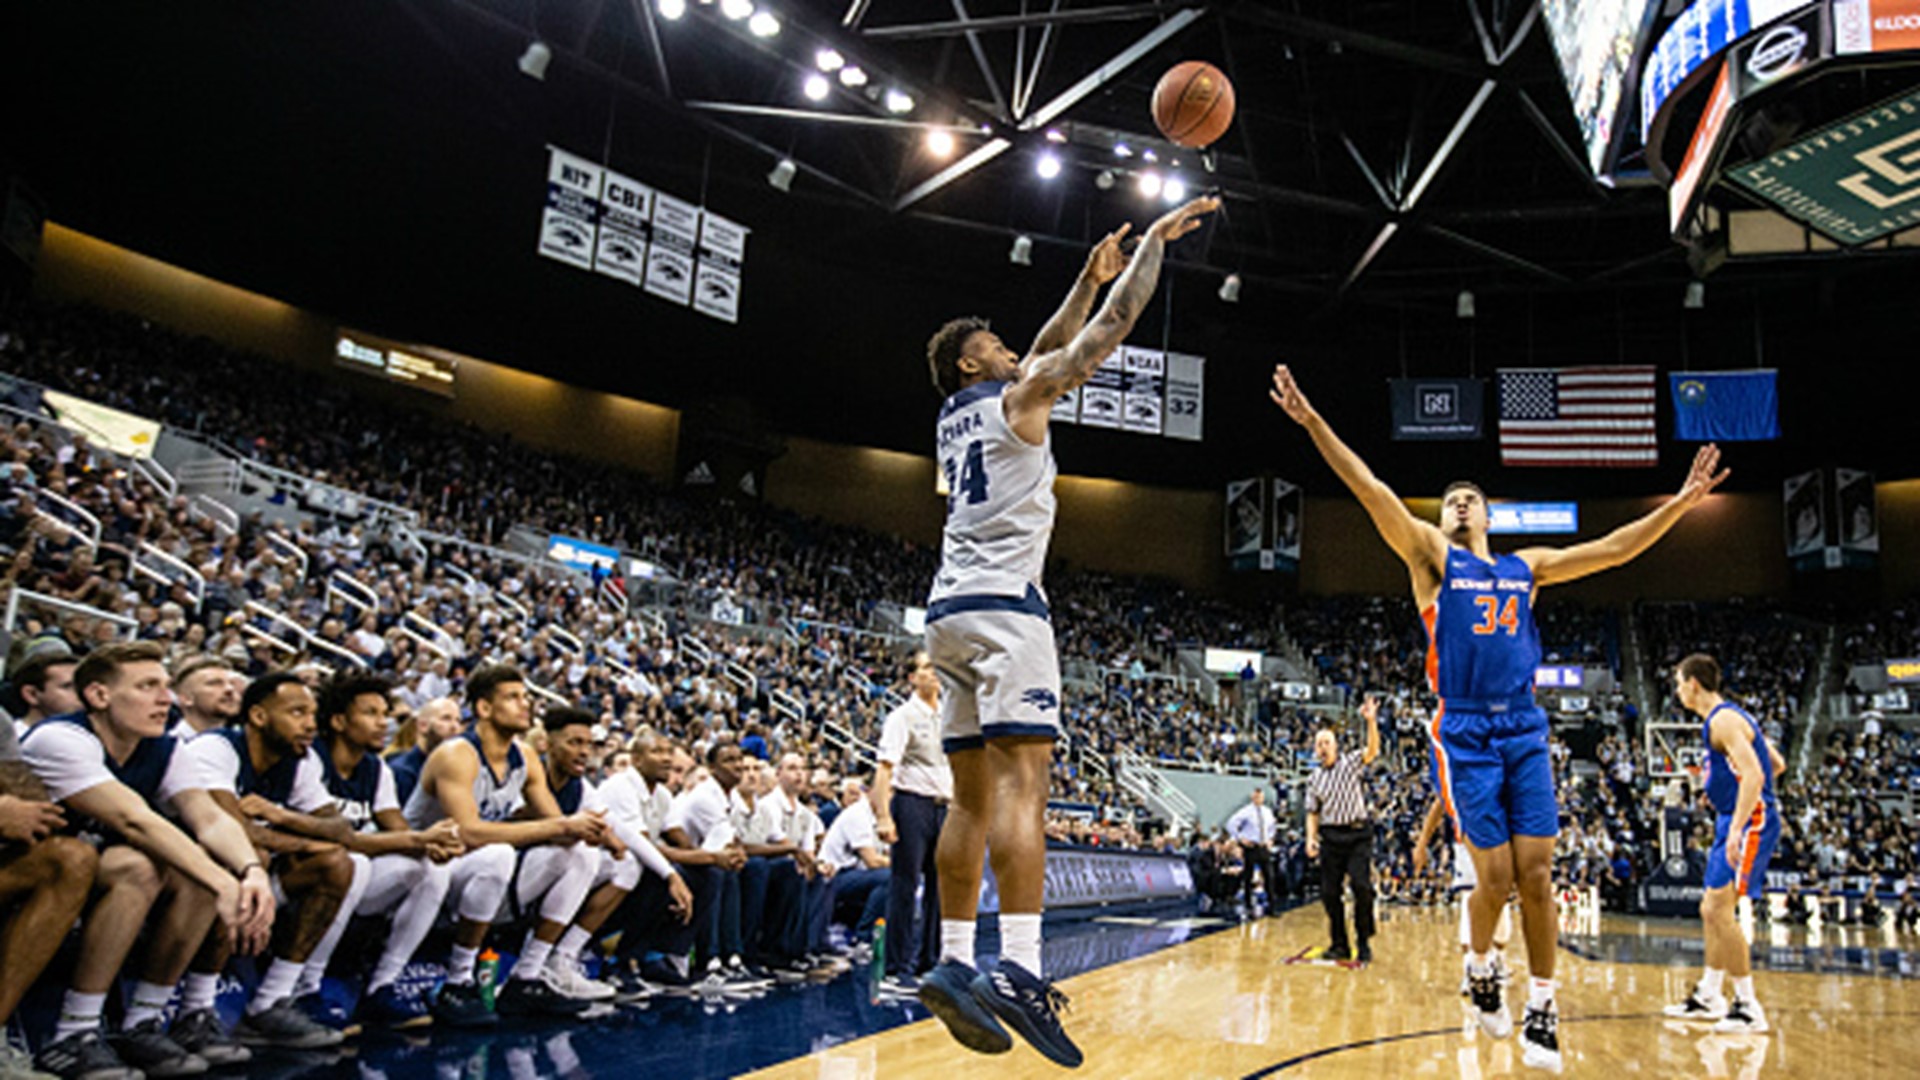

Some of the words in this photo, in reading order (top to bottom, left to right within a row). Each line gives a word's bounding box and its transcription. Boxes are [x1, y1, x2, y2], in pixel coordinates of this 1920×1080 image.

[607, 183, 645, 212] CBI
[1169, 399, 1198, 418] 32
[1472, 595, 1519, 636] 34
